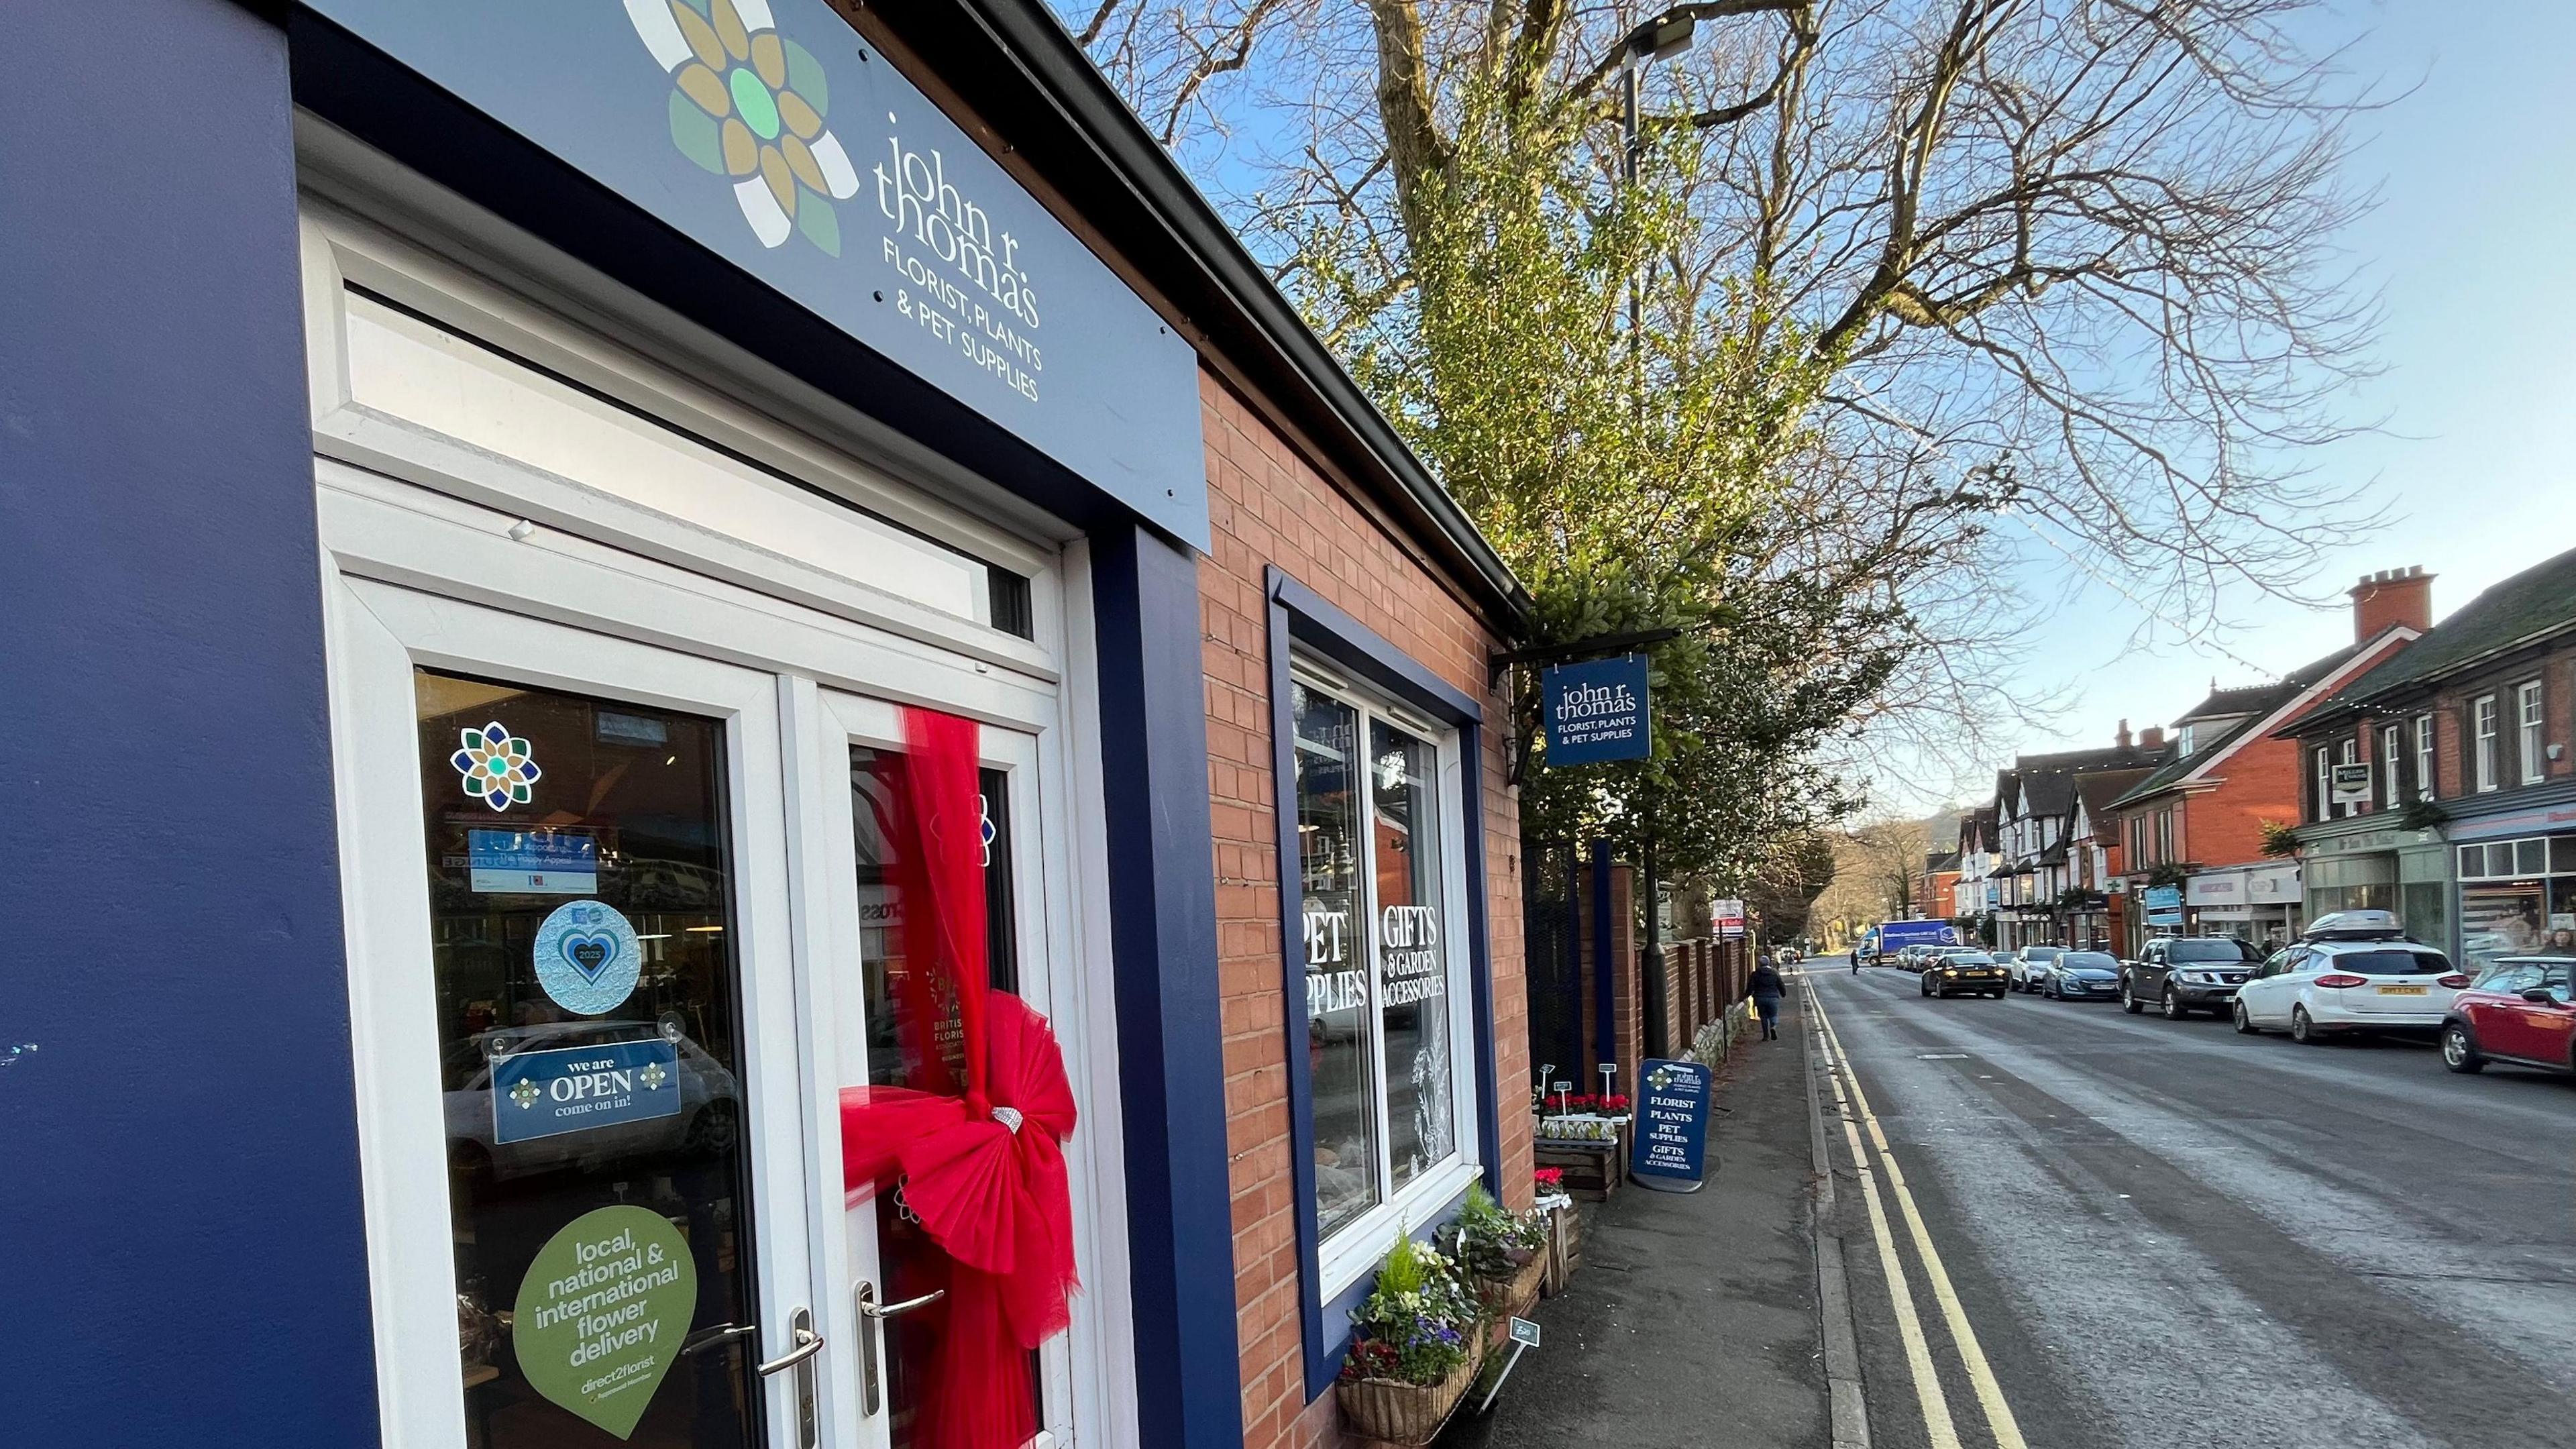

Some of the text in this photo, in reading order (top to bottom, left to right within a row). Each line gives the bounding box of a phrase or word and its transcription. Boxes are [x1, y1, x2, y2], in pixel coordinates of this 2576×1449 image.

[889, 111, 1028, 283] john r.
[872, 161, 1040, 329] thomas
[883, 236, 1042, 372] FLORIST, PLANTS
[897, 289, 1039, 402] & PET SUPPLIES
[1555, 695, 1636, 722] thomas
[1562, 682, 1612, 707] john
[1558, 716, 1636, 733] FLORIST, PLANTS
[1562, 729, 1632, 745] & PET SUPPLIES
[1383, 905, 1437, 948] GIFTS
[579, 951, 602, 959] 2025
[1387, 950, 1437, 979] & GARDEN
[1382, 975, 1444, 1008] ACCESSORIES
[568, 1057, 614, 1072] we are
[549, 1069, 632, 1103] OPEN
[555, 1095, 631, 1118] come on in!
[1650, 1096, 1696, 1109] FLORIST
[1650, 1110, 1693, 1122] PLANTS
[1649, 1132, 1688, 1143] SUPPLIES
[1658, 1124, 1680, 1134] PET
[1652, 1144, 1684, 1156] GIFTS
[1656, 1154, 1686, 1163] GARDEN
[576, 1228, 637, 1265] local,
[549, 1242, 665, 1299] national &
[535, 1260, 680, 1330] international
[577, 1299, 647, 1340] flower
[570, 1319, 659, 1368] delivery
[581, 1355, 655, 1394] direct2florist
